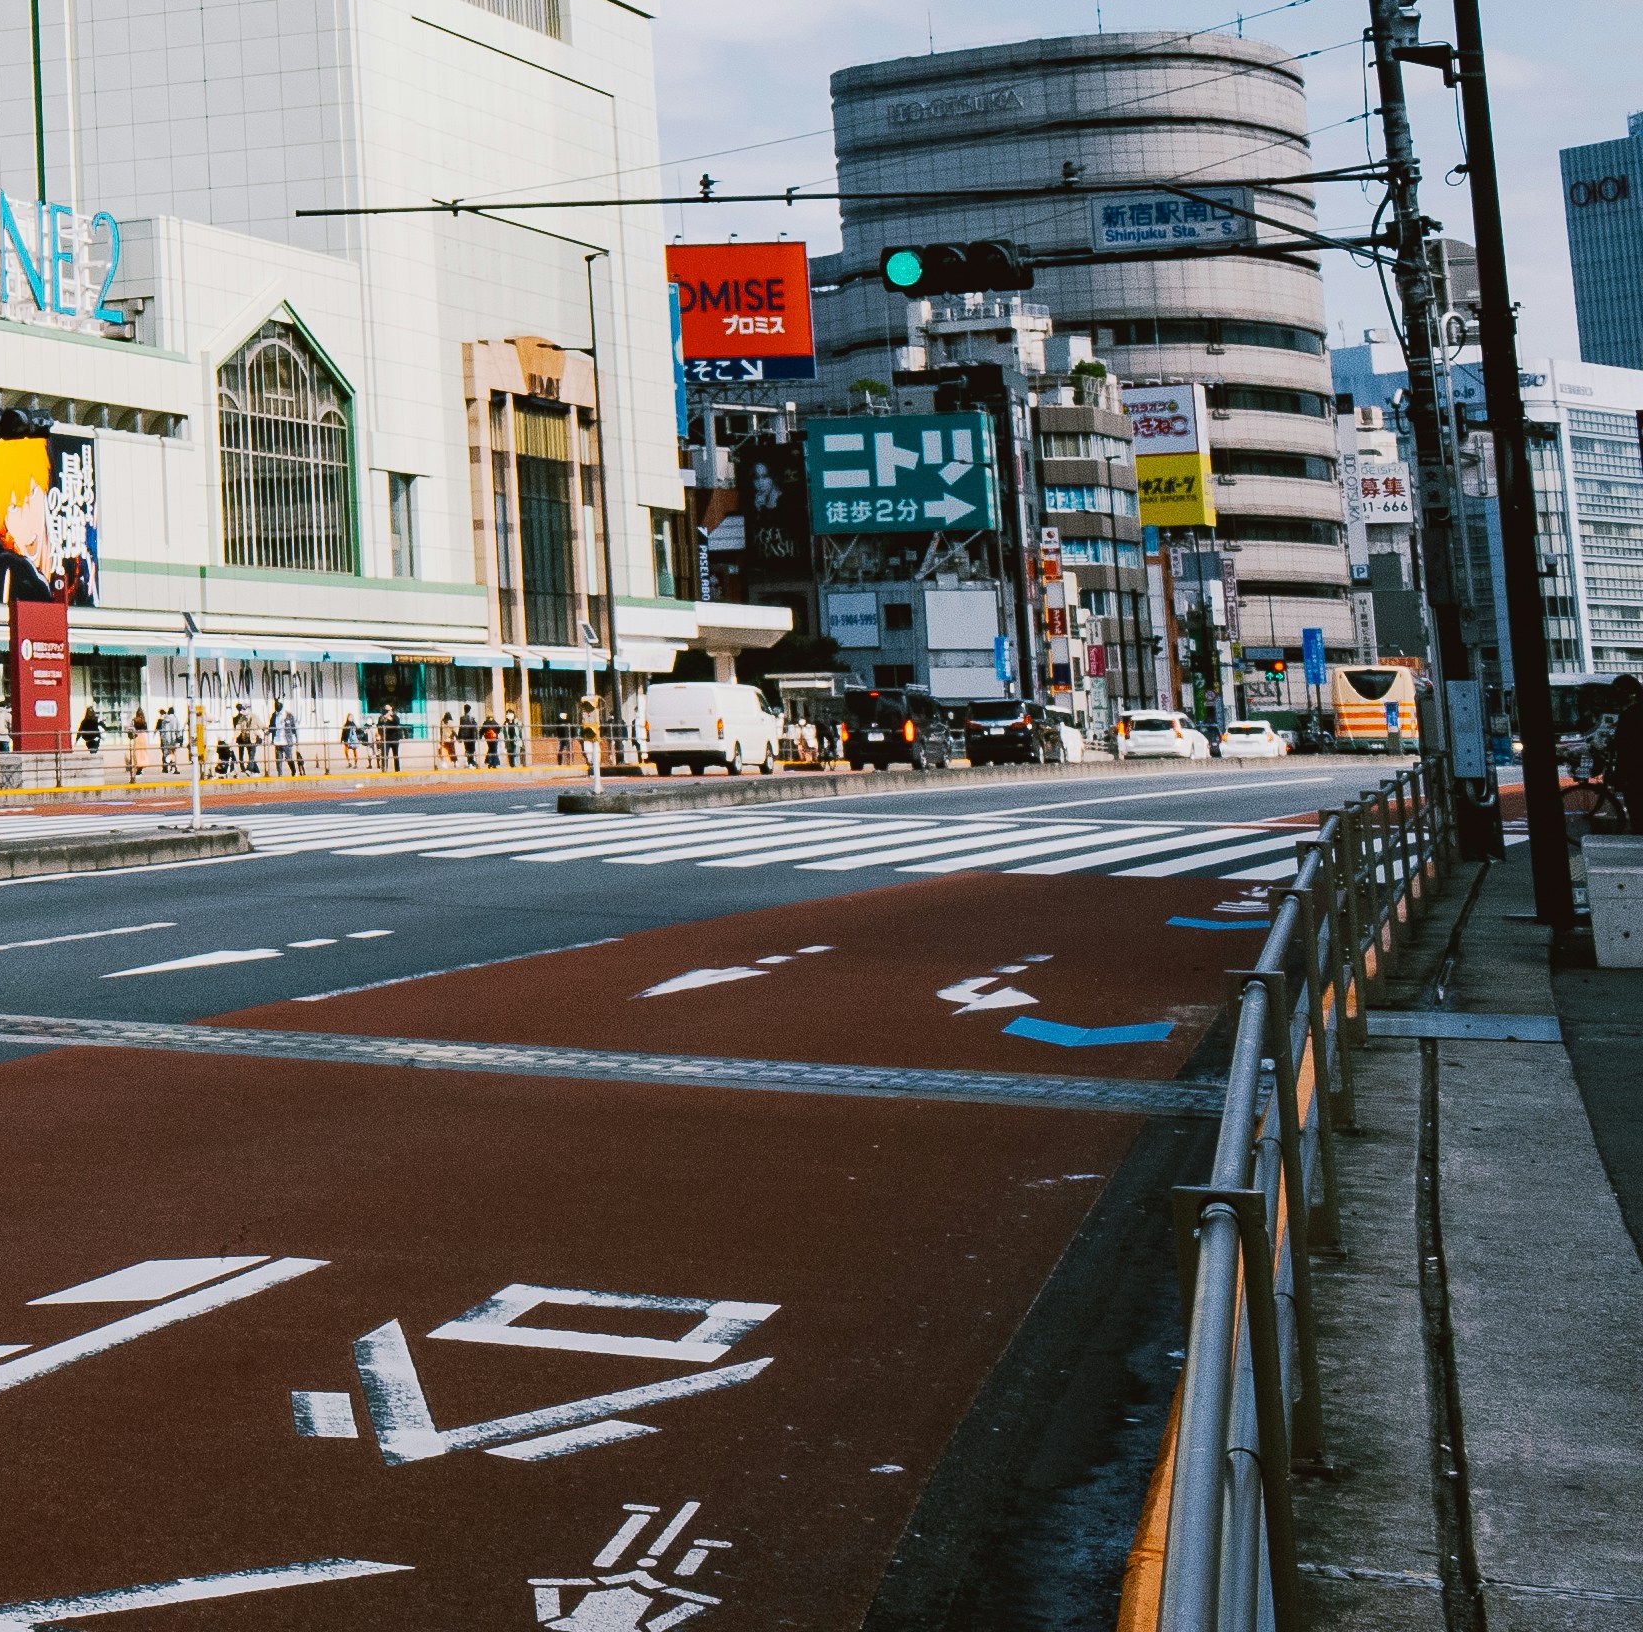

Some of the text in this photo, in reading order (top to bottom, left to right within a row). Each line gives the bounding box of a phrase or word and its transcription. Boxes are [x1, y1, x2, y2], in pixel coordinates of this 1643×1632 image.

[1105, 226, 1167, 244] Shinjuku
[91, 210, 123, 324] 2
[723, 315, 786, 336] プロミス
[684, 359, 733, 382] そこ
[822, 428, 974, 489] ニトリ
[1138, 476, 1196, 495] キスポーツ
[825, 498, 919, 524] 徒歩2分
